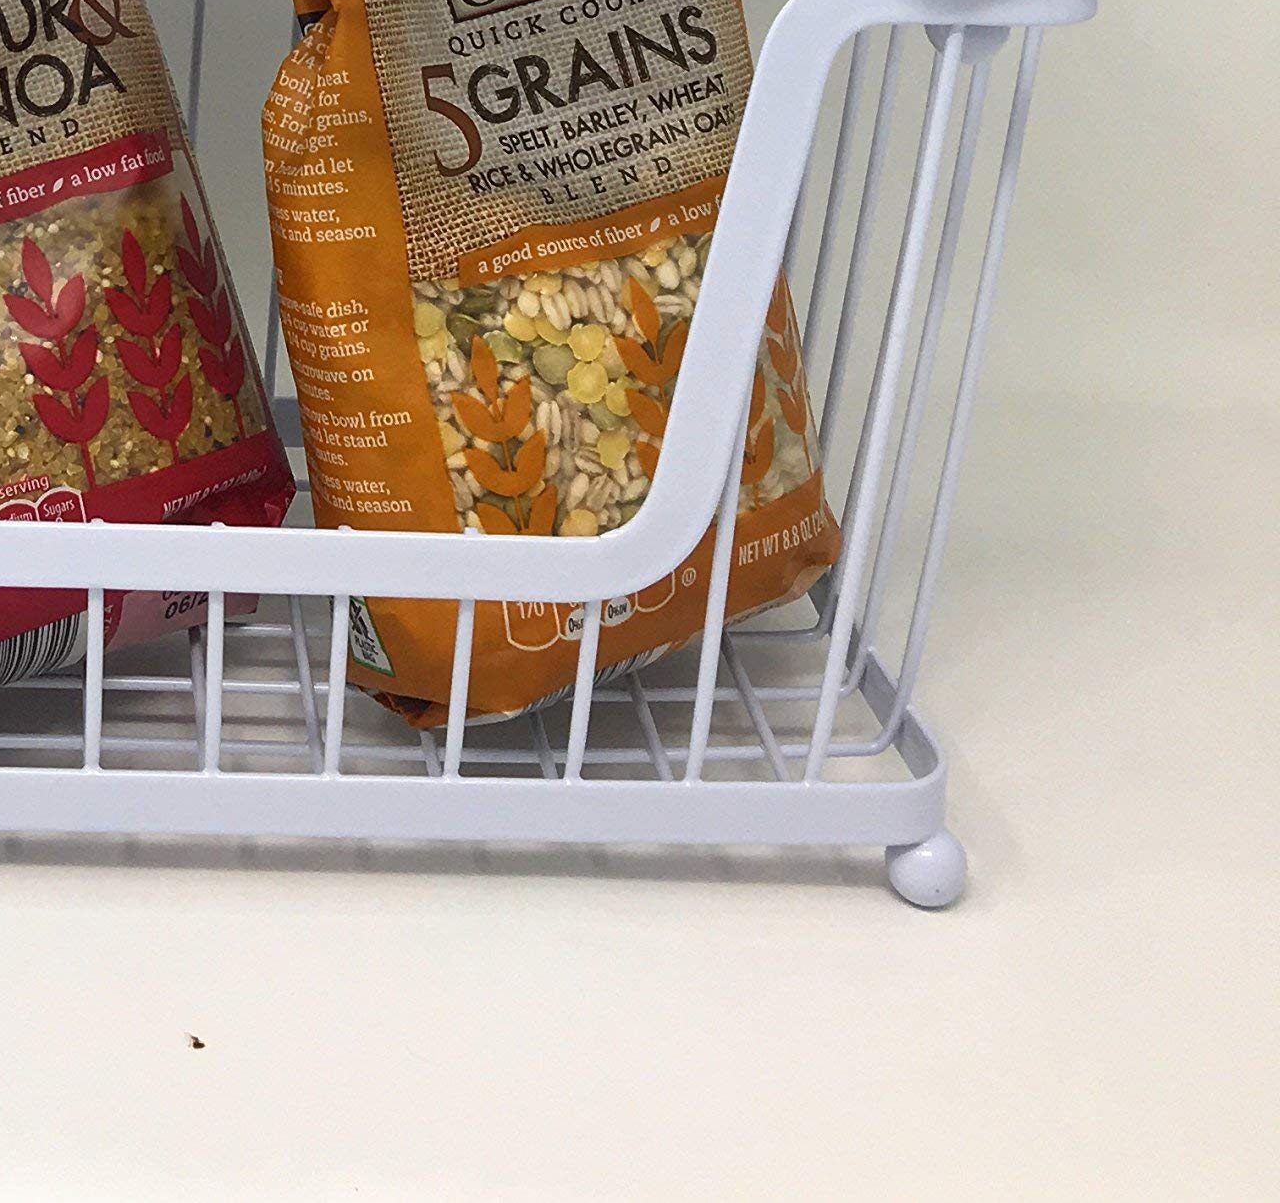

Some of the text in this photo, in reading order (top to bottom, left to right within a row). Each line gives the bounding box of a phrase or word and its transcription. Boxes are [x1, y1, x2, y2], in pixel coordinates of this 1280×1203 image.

[448, 9, 546, 57] QUICK
[317, 70, 349, 87] heat
[318, 90, 340, 106] for
[421, 5, 718, 177] 5 GRAINS
[316, 109, 373, 132] grains,
[499, 74, 729, 156] SPELT, BARLEY, WHEAT,
[331, 158, 354, 173] let
[467, 167, 515, 195] RICE
[520, 163, 536, 183] &
[536, 118, 690, 179] WHOLEGRAIN
[6, 182, 46, 207] fiber
[70, 173, 82, 187] a
[82, 161, 117, 185] low
[120, 152, 145, 173] fat
[282, 180, 349, 196] minutes.
[542, 155, 672, 205] BLEND
[291, 208, 341, 224] water,
[288, 226, 376, 243] and season
[477, 200, 713, 275] a good source of fiber a low
[326, 299, 369, 319] dish,
[308, 322, 347, 338] water
[351, 320, 369, 333] or
[319, 342, 370, 361] grains.
[351, 369, 375, 382] on
[330, 409, 365, 429] bowl
[370, 410, 412, 427] from
[324, 429, 341, 446] let
[343, 431, 388, 447] stand
[0, 475, 50, 500] serving
[343, 478, 391, 495] water,
[43, 499, 75, 517] Sugars
[356, 498, 412, 513] season
[739, 517, 813, 566] NET WT 8.8 OZ
